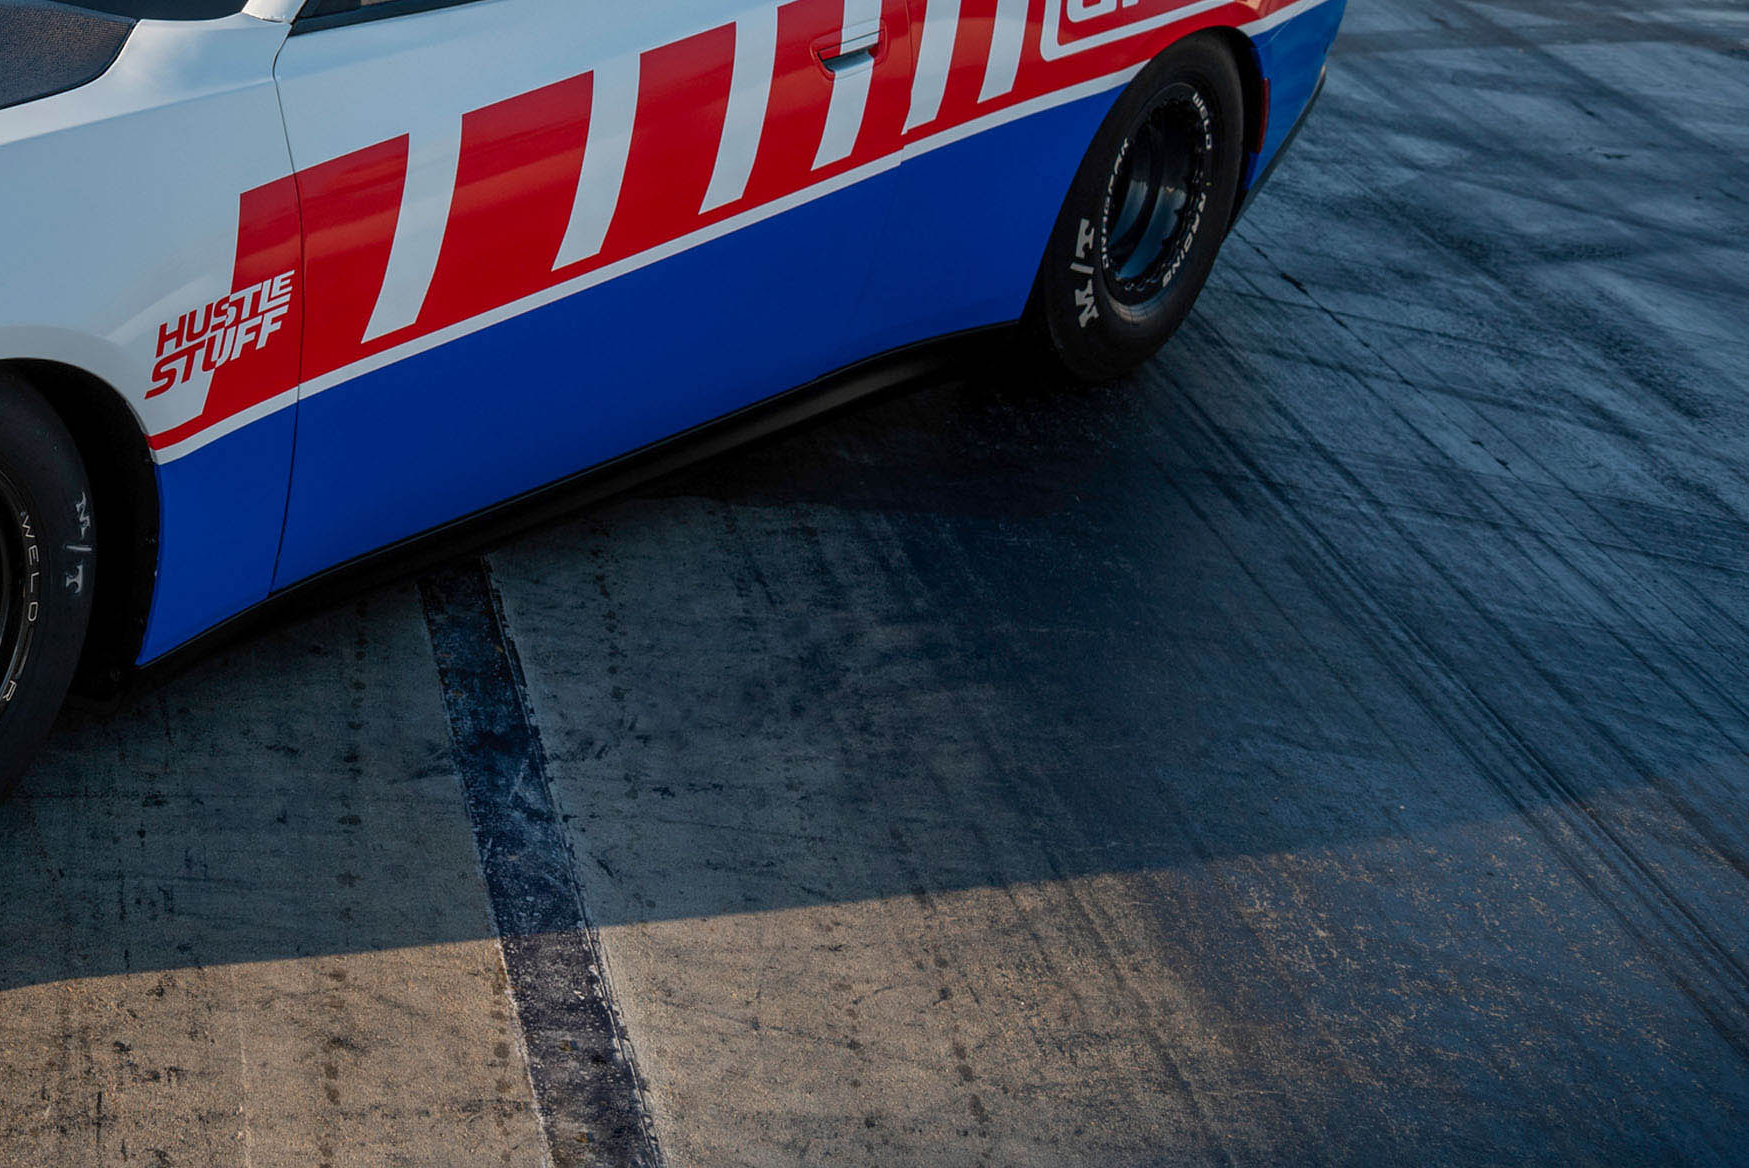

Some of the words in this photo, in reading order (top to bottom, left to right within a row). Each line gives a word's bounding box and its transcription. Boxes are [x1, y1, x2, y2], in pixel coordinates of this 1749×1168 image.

[144, 304, 290, 400] STUFF
[155, 270, 296, 358] HUSTLE
[19, 511, 40, 623] WELD
